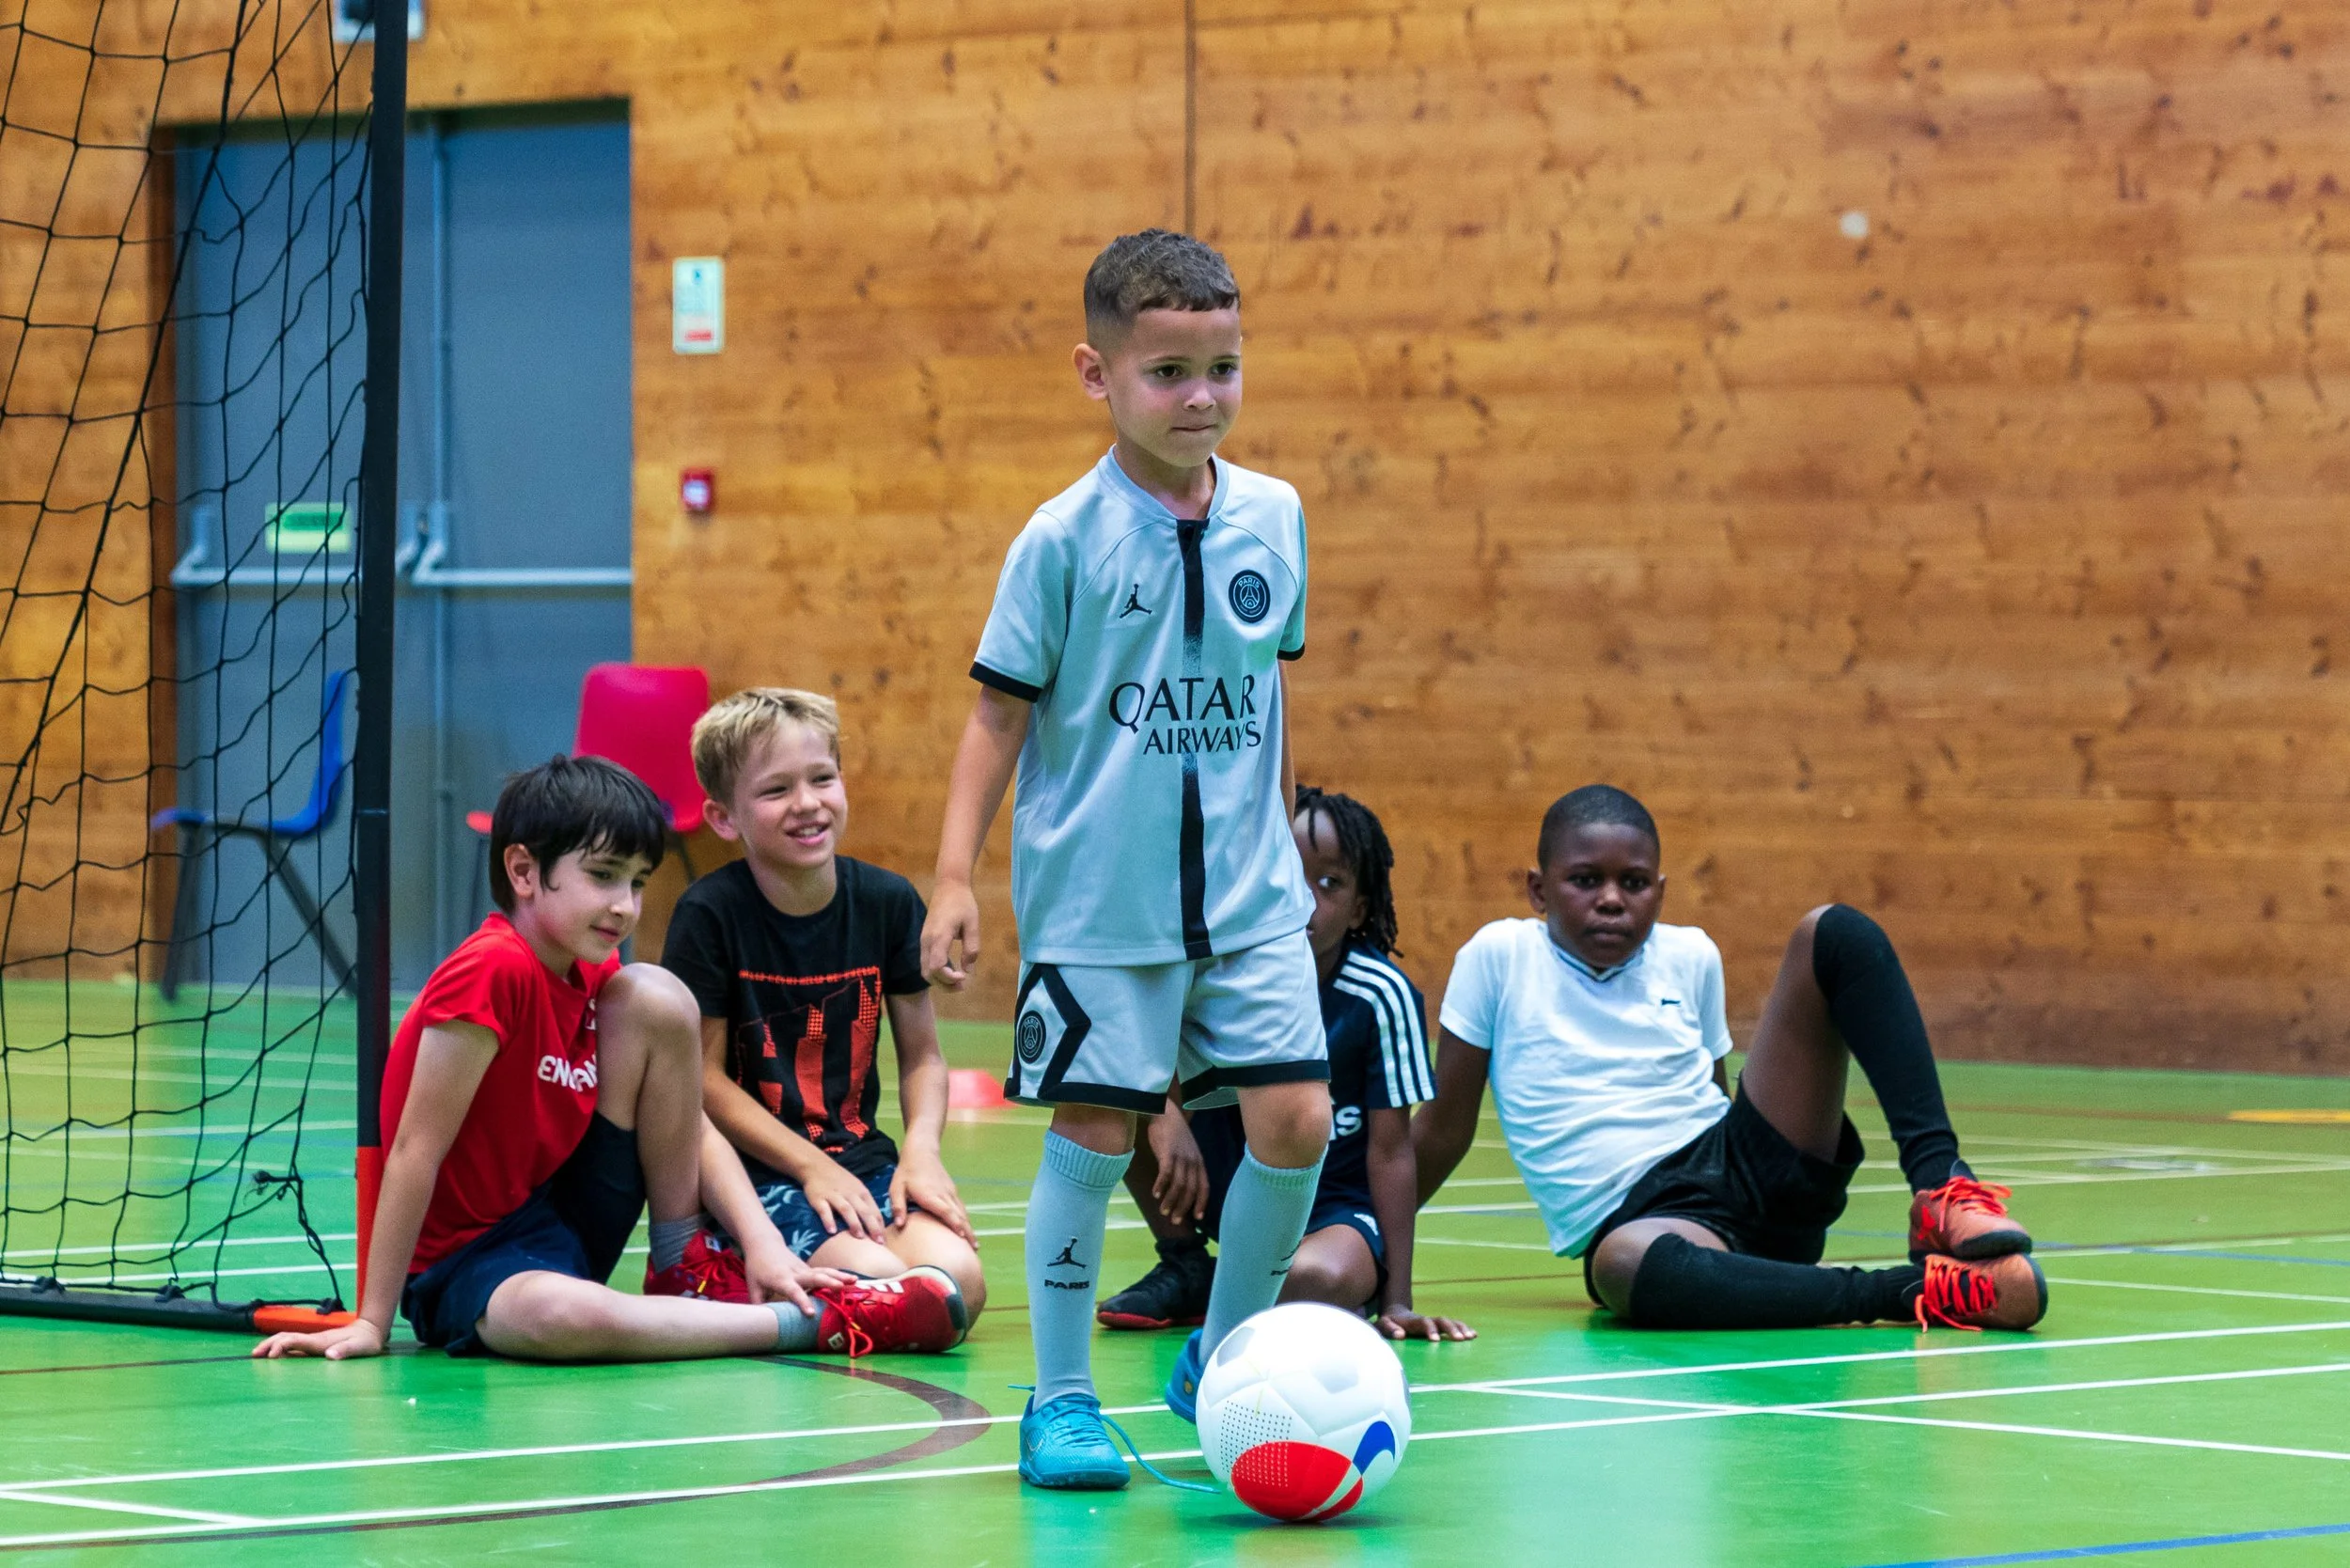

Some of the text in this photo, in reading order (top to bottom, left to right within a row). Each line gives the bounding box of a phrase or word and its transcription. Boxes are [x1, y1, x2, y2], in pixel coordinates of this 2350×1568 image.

[1238, 577, 1261, 588] PARIS
[1108, 674, 1257, 734] QATAR
[1143, 720, 1261, 755] AIRWAYS
